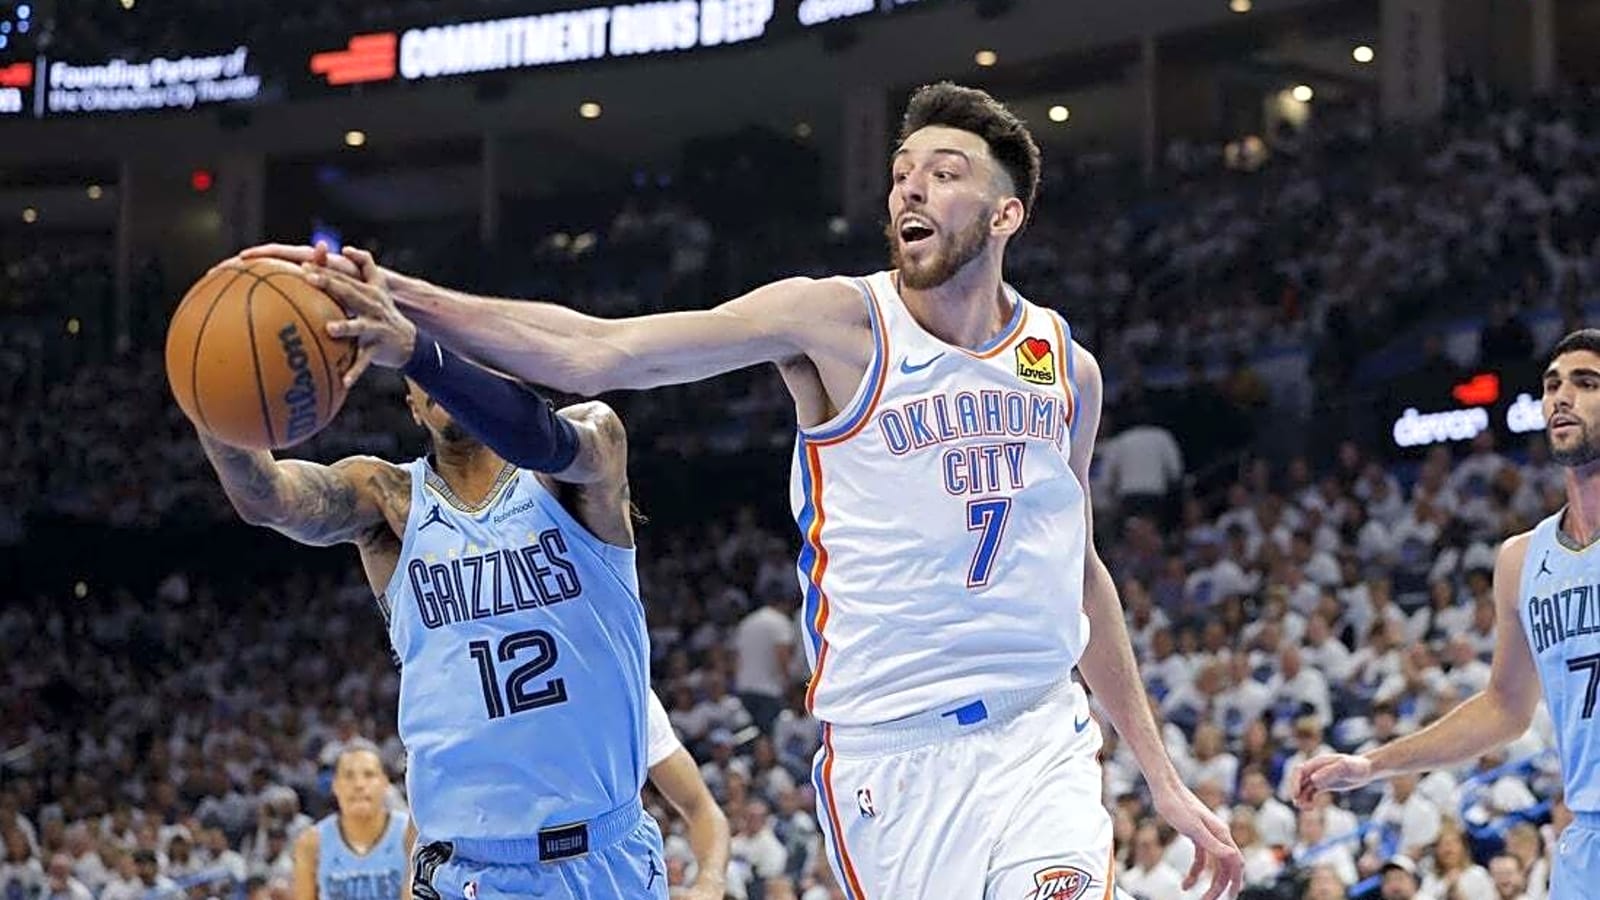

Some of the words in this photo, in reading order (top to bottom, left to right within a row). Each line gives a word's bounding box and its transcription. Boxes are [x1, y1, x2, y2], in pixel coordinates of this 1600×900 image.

[50, 60, 150, 91] Founding
[151, 57, 222, 84] Partner
[222, 46, 247, 77] of
[401, 8, 608, 78] COMMITMENT
[611, 1, 698, 56] RUNS
[700, 0, 774, 46] DEEP
[49, 89, 79, 111] the
[80, 86, 165, 111] Oklahoma
[165, 83, 196, 109] City
[196, 76, 260, 100] Thunder
[279, 321, 318, 440] Wilson
[1020, 364, 1052, 380] Love's
[943, 442, 1026, 495] CITY
[966, 498, 1012, 588] 7
[408, 528, 582, 630] GRIZZLIES
[1529, 584, 1600, 654] GRIZZL
[468, 628, 568, 720] 12
[1037, 873, 1080, 900] OKC
